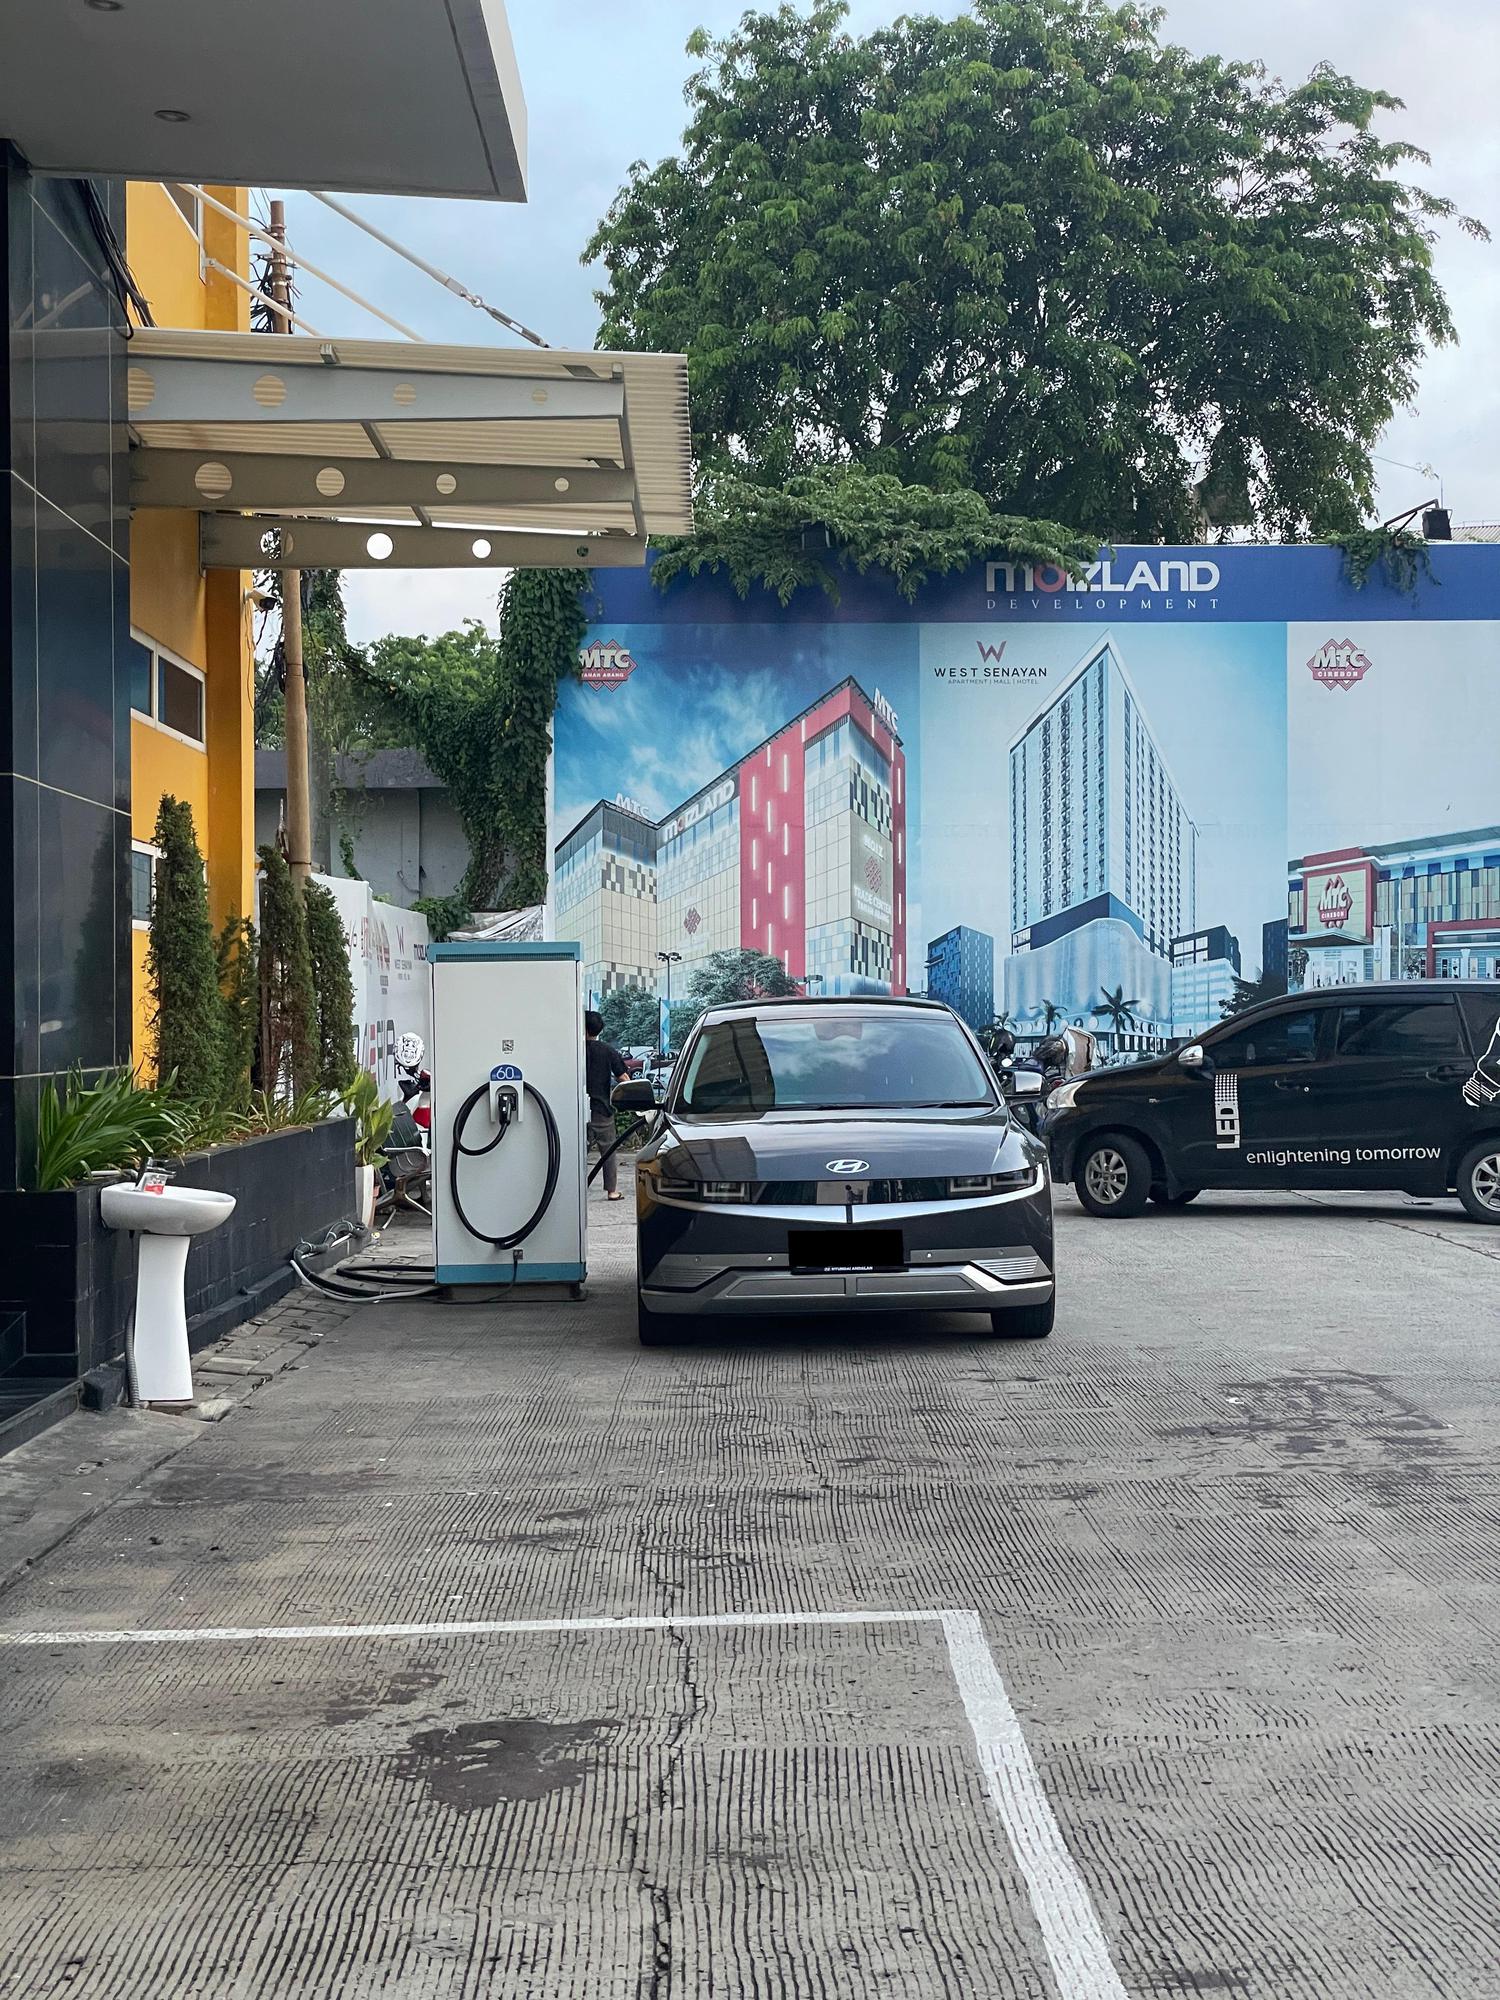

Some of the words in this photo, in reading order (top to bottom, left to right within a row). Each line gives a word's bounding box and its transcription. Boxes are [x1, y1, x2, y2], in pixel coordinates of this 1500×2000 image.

[986, 599, 1219, 609] DEVELOPMENT
[578, 649, 631, 668] MTC
[976, 640, 1007, 663] W
[1312, 648, 1366, 669] MTC
[934, 667, 978, 677] WEST
[983, 667, 1047, 677] SENAYAN
[1320, 886, 1348, 911] MTC
[496, 1066, 514, 1080] 60
[1216, 1101, 1240, 1149] LED
[1246, 1148, 1351, 1166] enlightening
[1355, 1147, 1441, 1161] tomorrow
